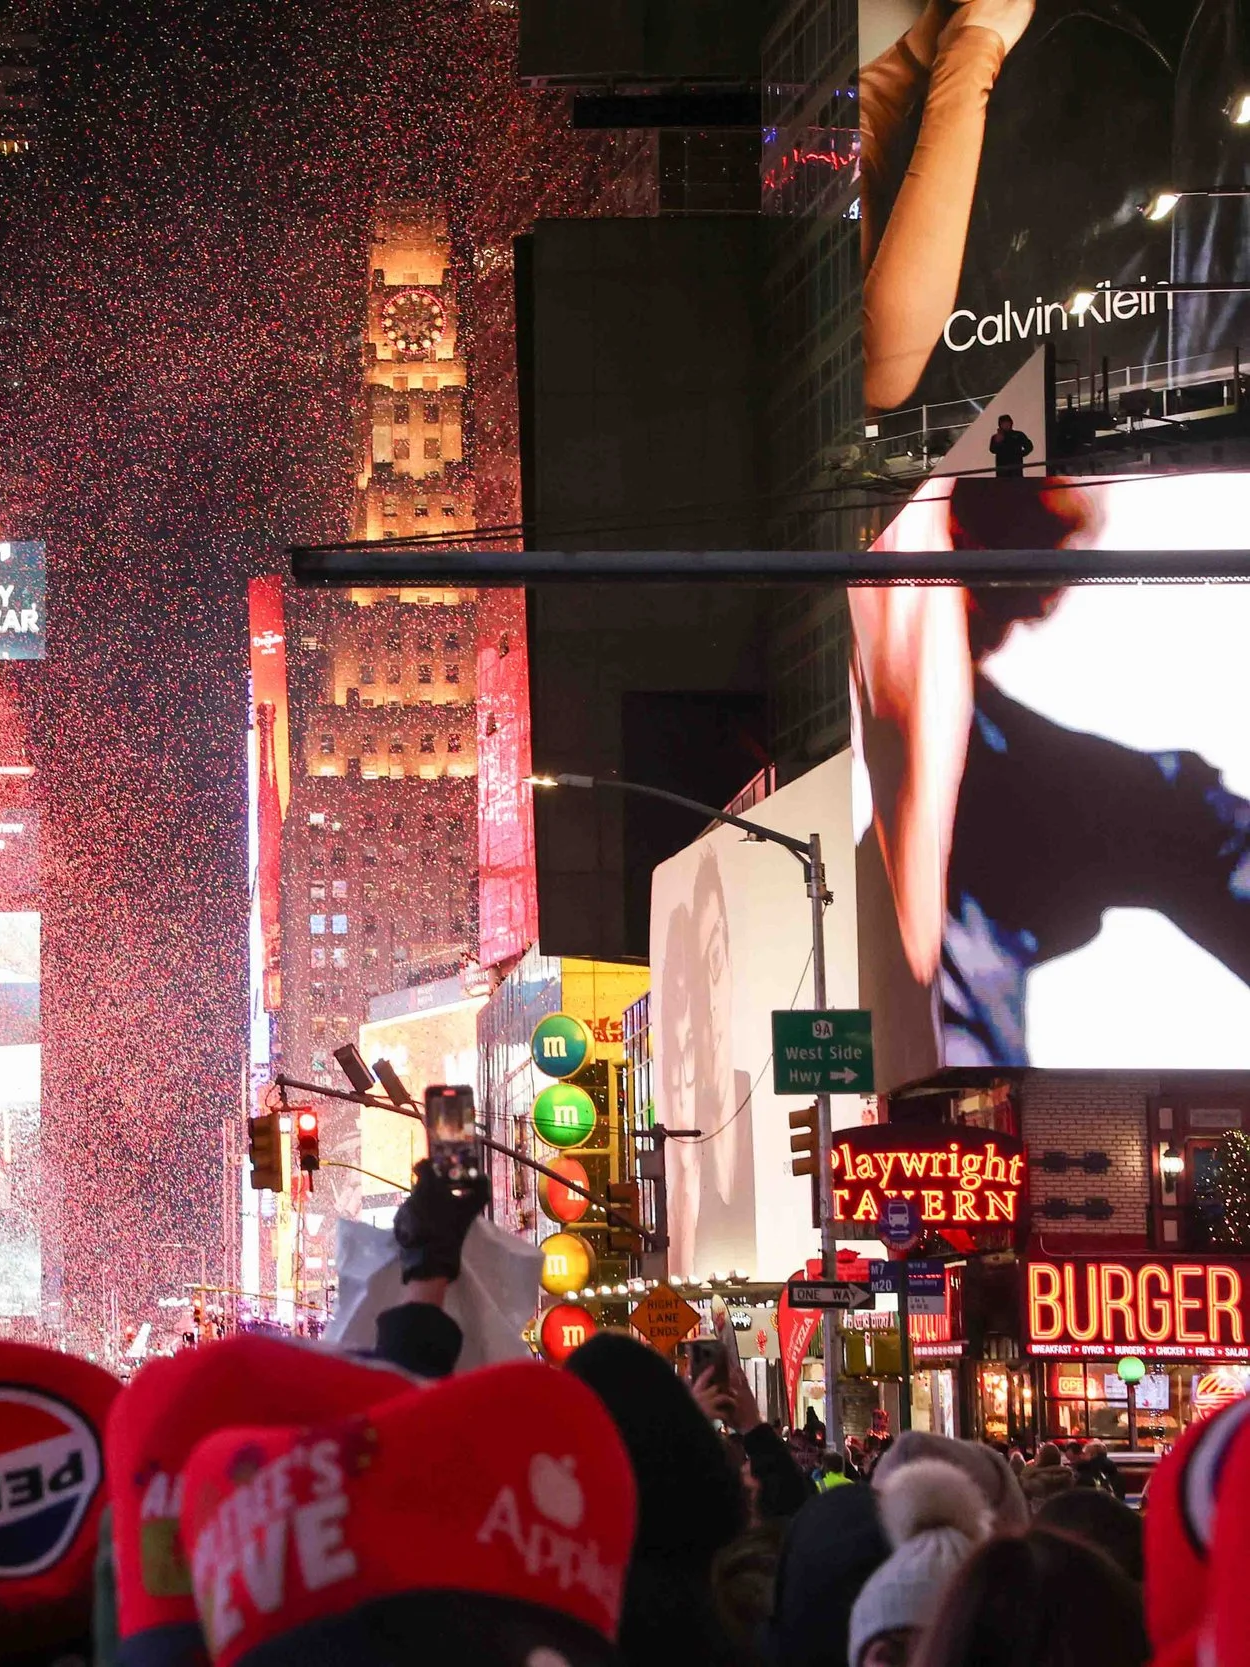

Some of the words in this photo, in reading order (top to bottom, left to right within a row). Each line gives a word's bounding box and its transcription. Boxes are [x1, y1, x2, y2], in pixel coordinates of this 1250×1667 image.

[944, 296, 1068, 352] Calvin
[814, 1022, 831, 1037] 9A
[543, 1035, 567, 1058] m
[786, 1046, 822, 1060] West
[830, 1045, 862, 1060] Side
[789, 1068, 822, 1086] Hwy
[553, 1104, 580, 1127] m
[567, 1179, 587, 1202] m
[832, 1189, 1017, 1221] TAERN
[545, 1254, 568, 1276] m
[871, 1263, 885, 1275] M7
[797, 1288, 821, 1300] ONE
[832, 1288, 858, 1300] WAY
[871, 1279, 892, 1292] M20
[1028, 1263, 1245, 1343] BURGER
[648, 1314, 679, 1324] LANE
[562, 1325, 585, 1347] m
[649, 1327, 680, 1337] ENDS
[791, 1316, 815, 1365] PIZZA
[1031, 1344, 1072, 1354] BREAKFAST
[1081, 1345, 1105, 1355] GYROS
[1114, 1346, 1146, 1356] BURGERS
[1155, 1346, 1186, 1356] CHICKEN
[1195, 1347, 1215, 1356] FRIES
[1225, 1347, 1249, 1357] SALAD
[1061, 1379, 1083, 1393] OPE
